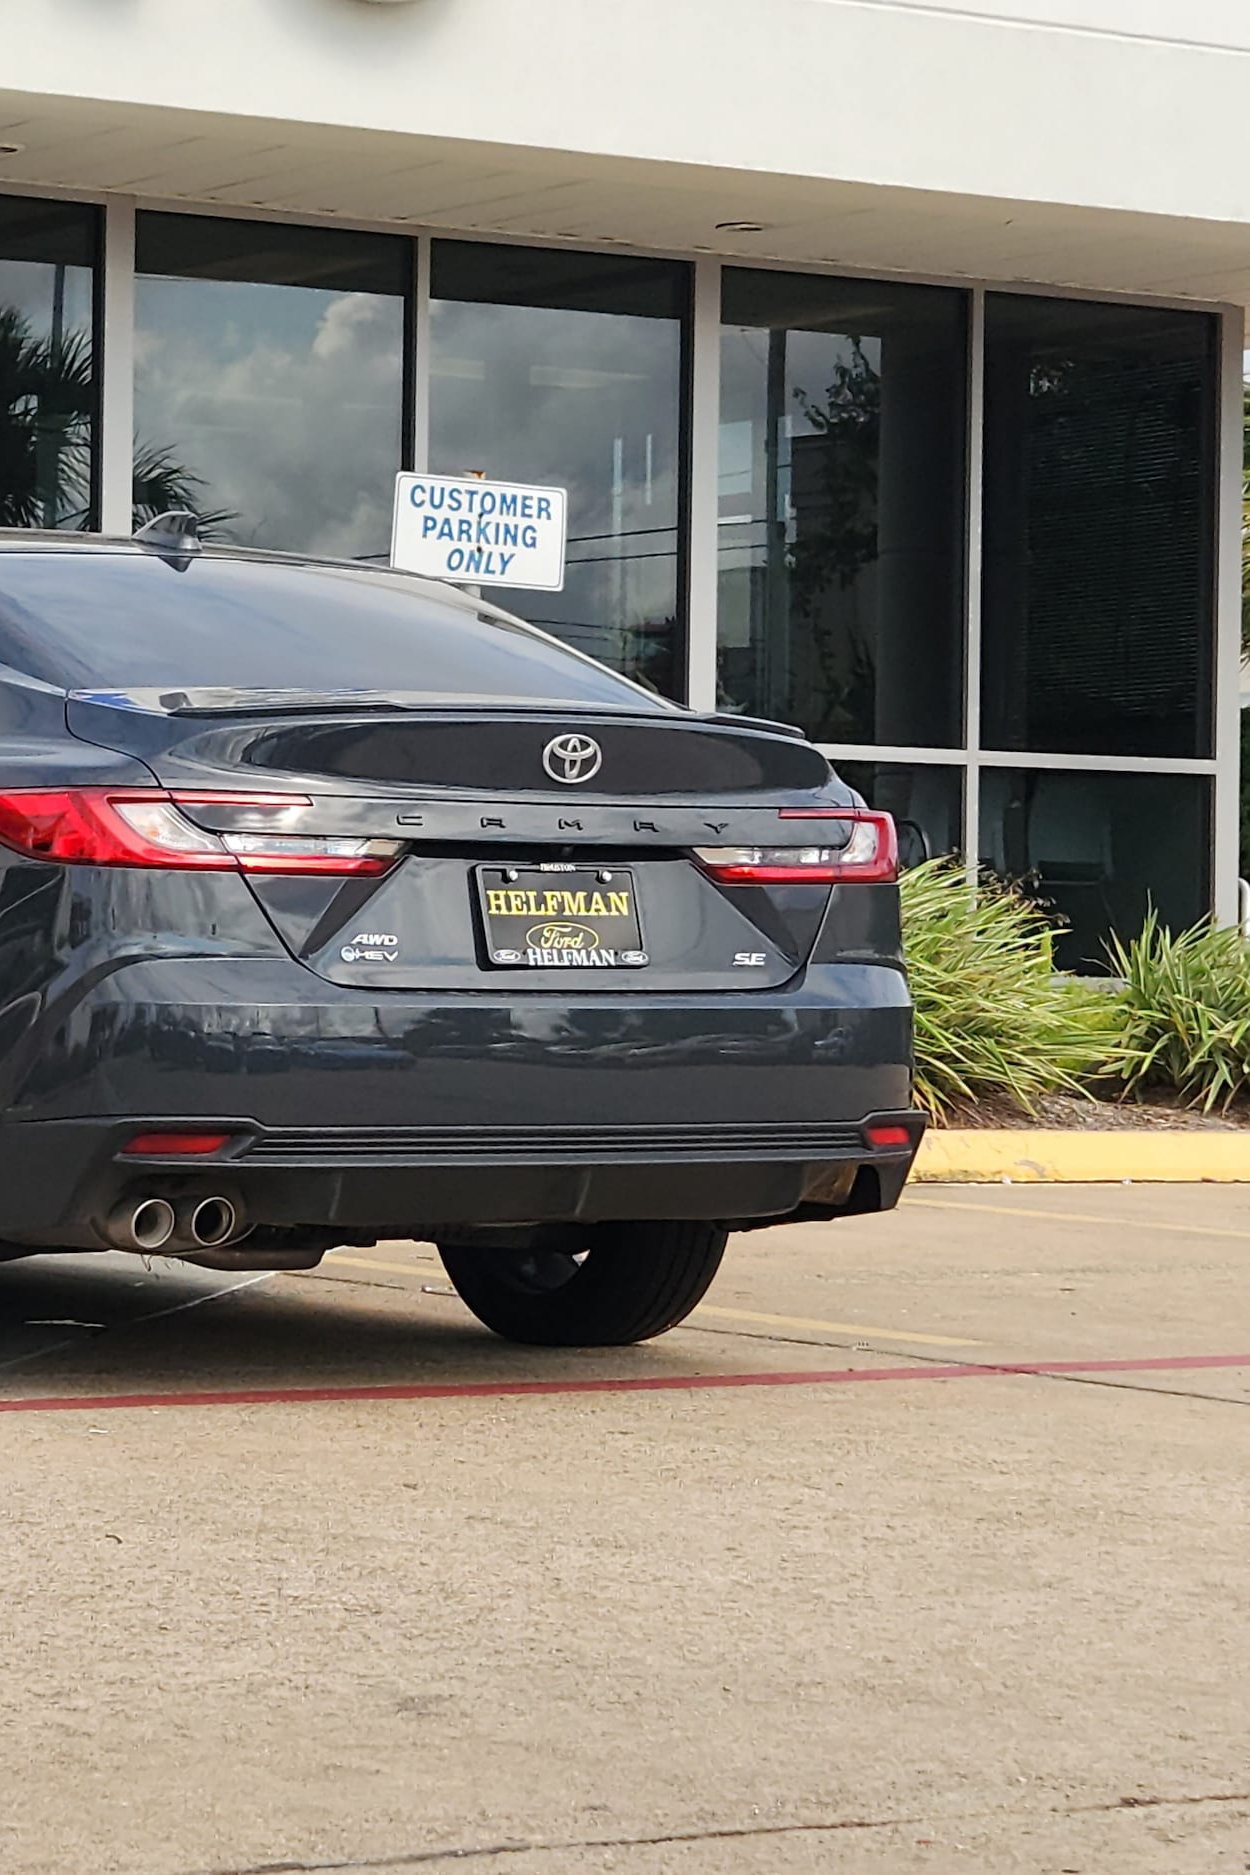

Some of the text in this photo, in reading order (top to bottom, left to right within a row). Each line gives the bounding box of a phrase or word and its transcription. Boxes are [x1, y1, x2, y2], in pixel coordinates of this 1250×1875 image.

[410, 484, 552, 520] CUSTOMER
[422, 515, 537, 549] PARKING
[447, 548, 516, 576] ONLY
[486, 890, 629, 916] HELFMAN
[350, 933, 398, 946] AWD
[541, 925, 585, 949] Ford
[527, 948, 617, 967] HELFMAN
[732, 952, 767, 966] SE
